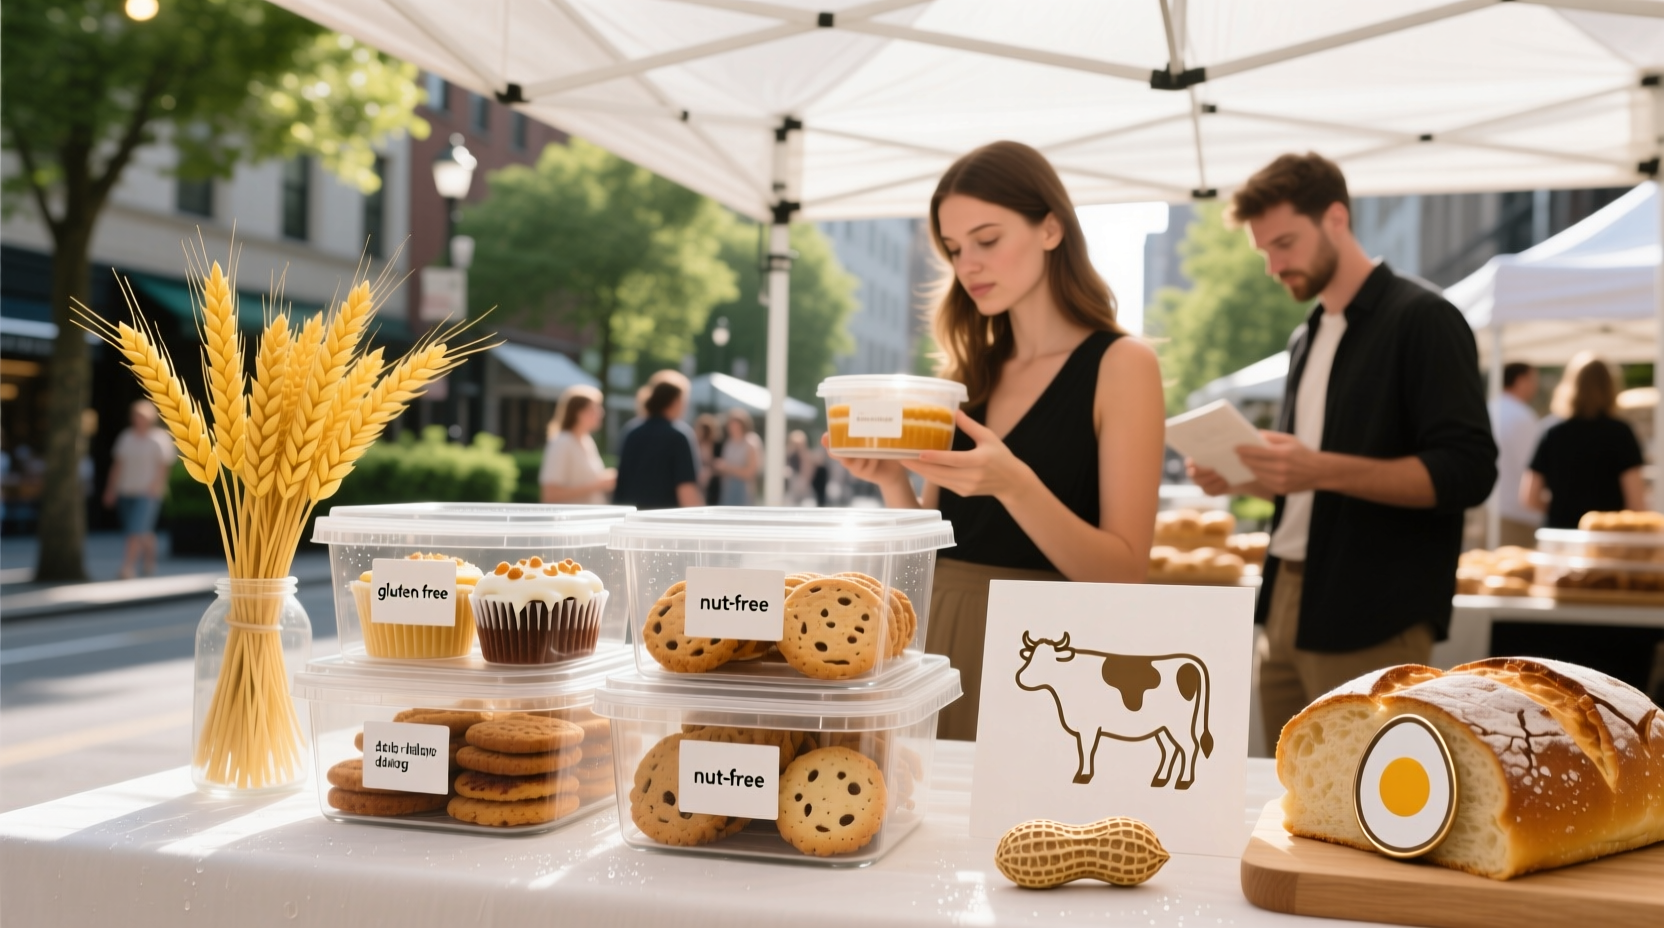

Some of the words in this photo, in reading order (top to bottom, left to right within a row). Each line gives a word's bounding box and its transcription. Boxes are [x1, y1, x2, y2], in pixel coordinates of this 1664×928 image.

[378, 582, 419, 601] gluten
[422, 584, 449, 600] free
[700, 594, 769, 612] nut-free
[694, 768, 765, 788] nut-free
